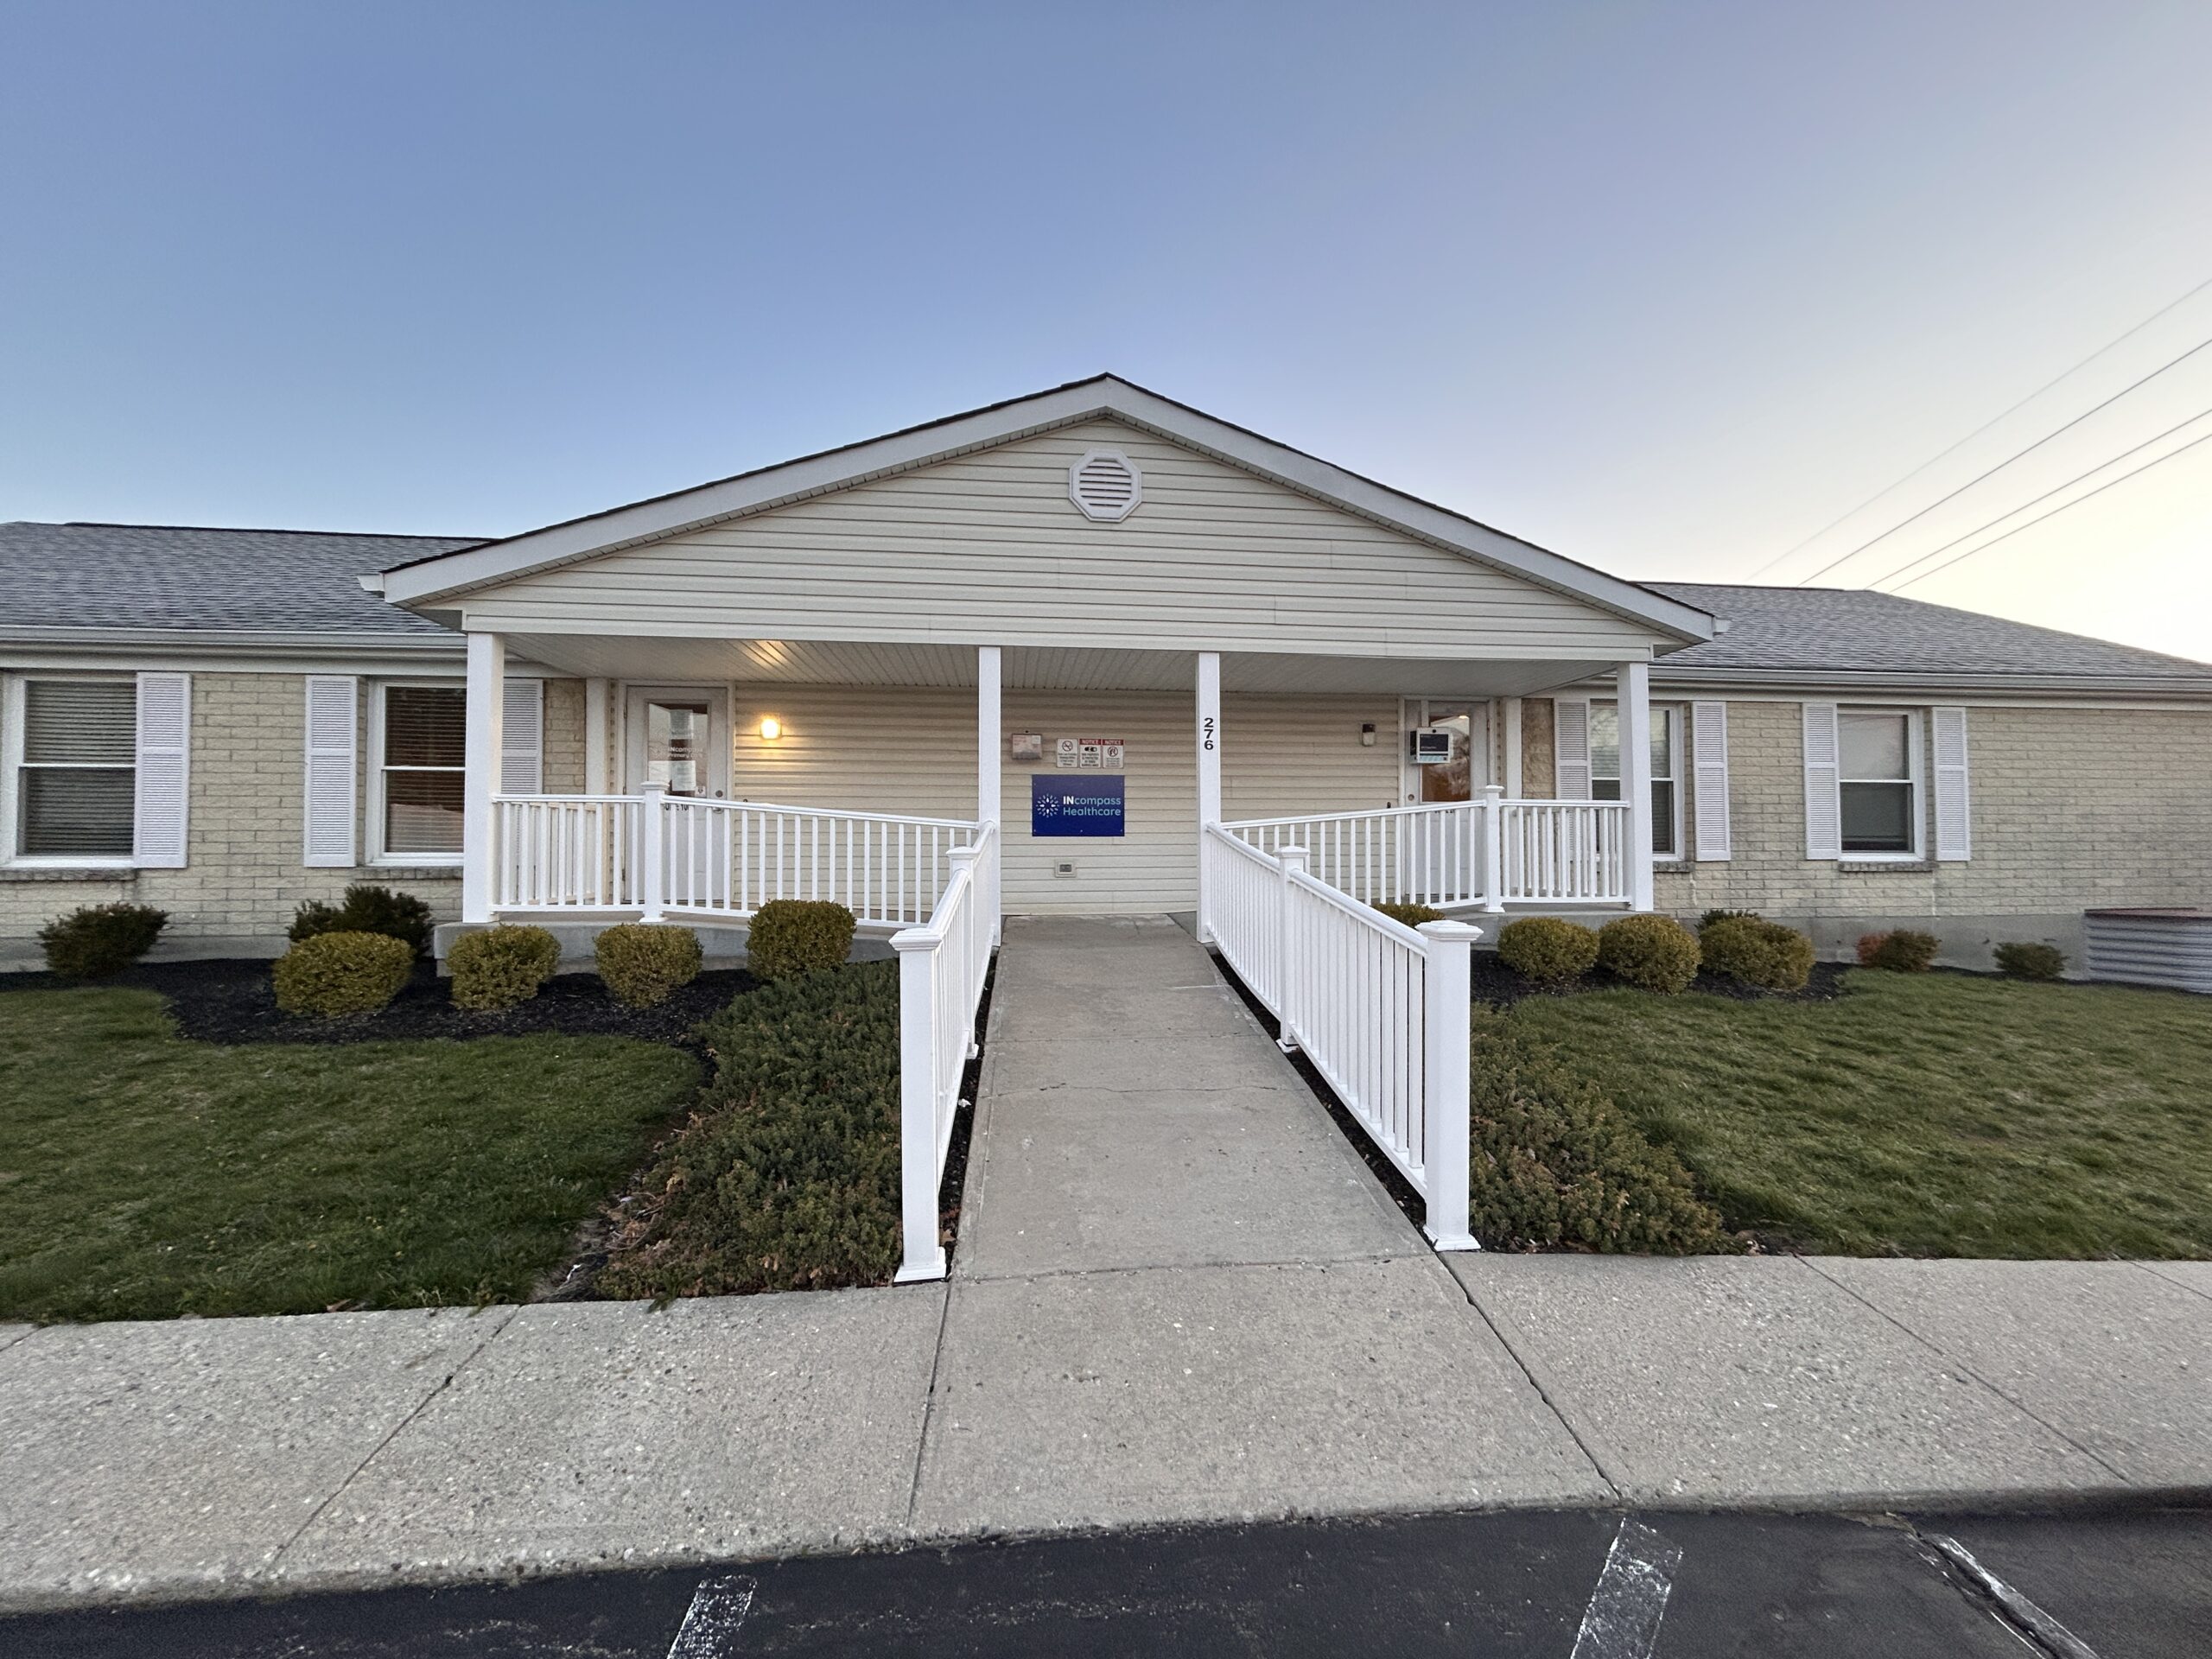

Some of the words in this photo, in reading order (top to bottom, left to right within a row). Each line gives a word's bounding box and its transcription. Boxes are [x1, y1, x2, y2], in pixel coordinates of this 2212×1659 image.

[1204, 717, 1214, 750] 276
[1063, 796, 1122, 807] INcompass
[1063, 806, 1122, 816] Healthcare
